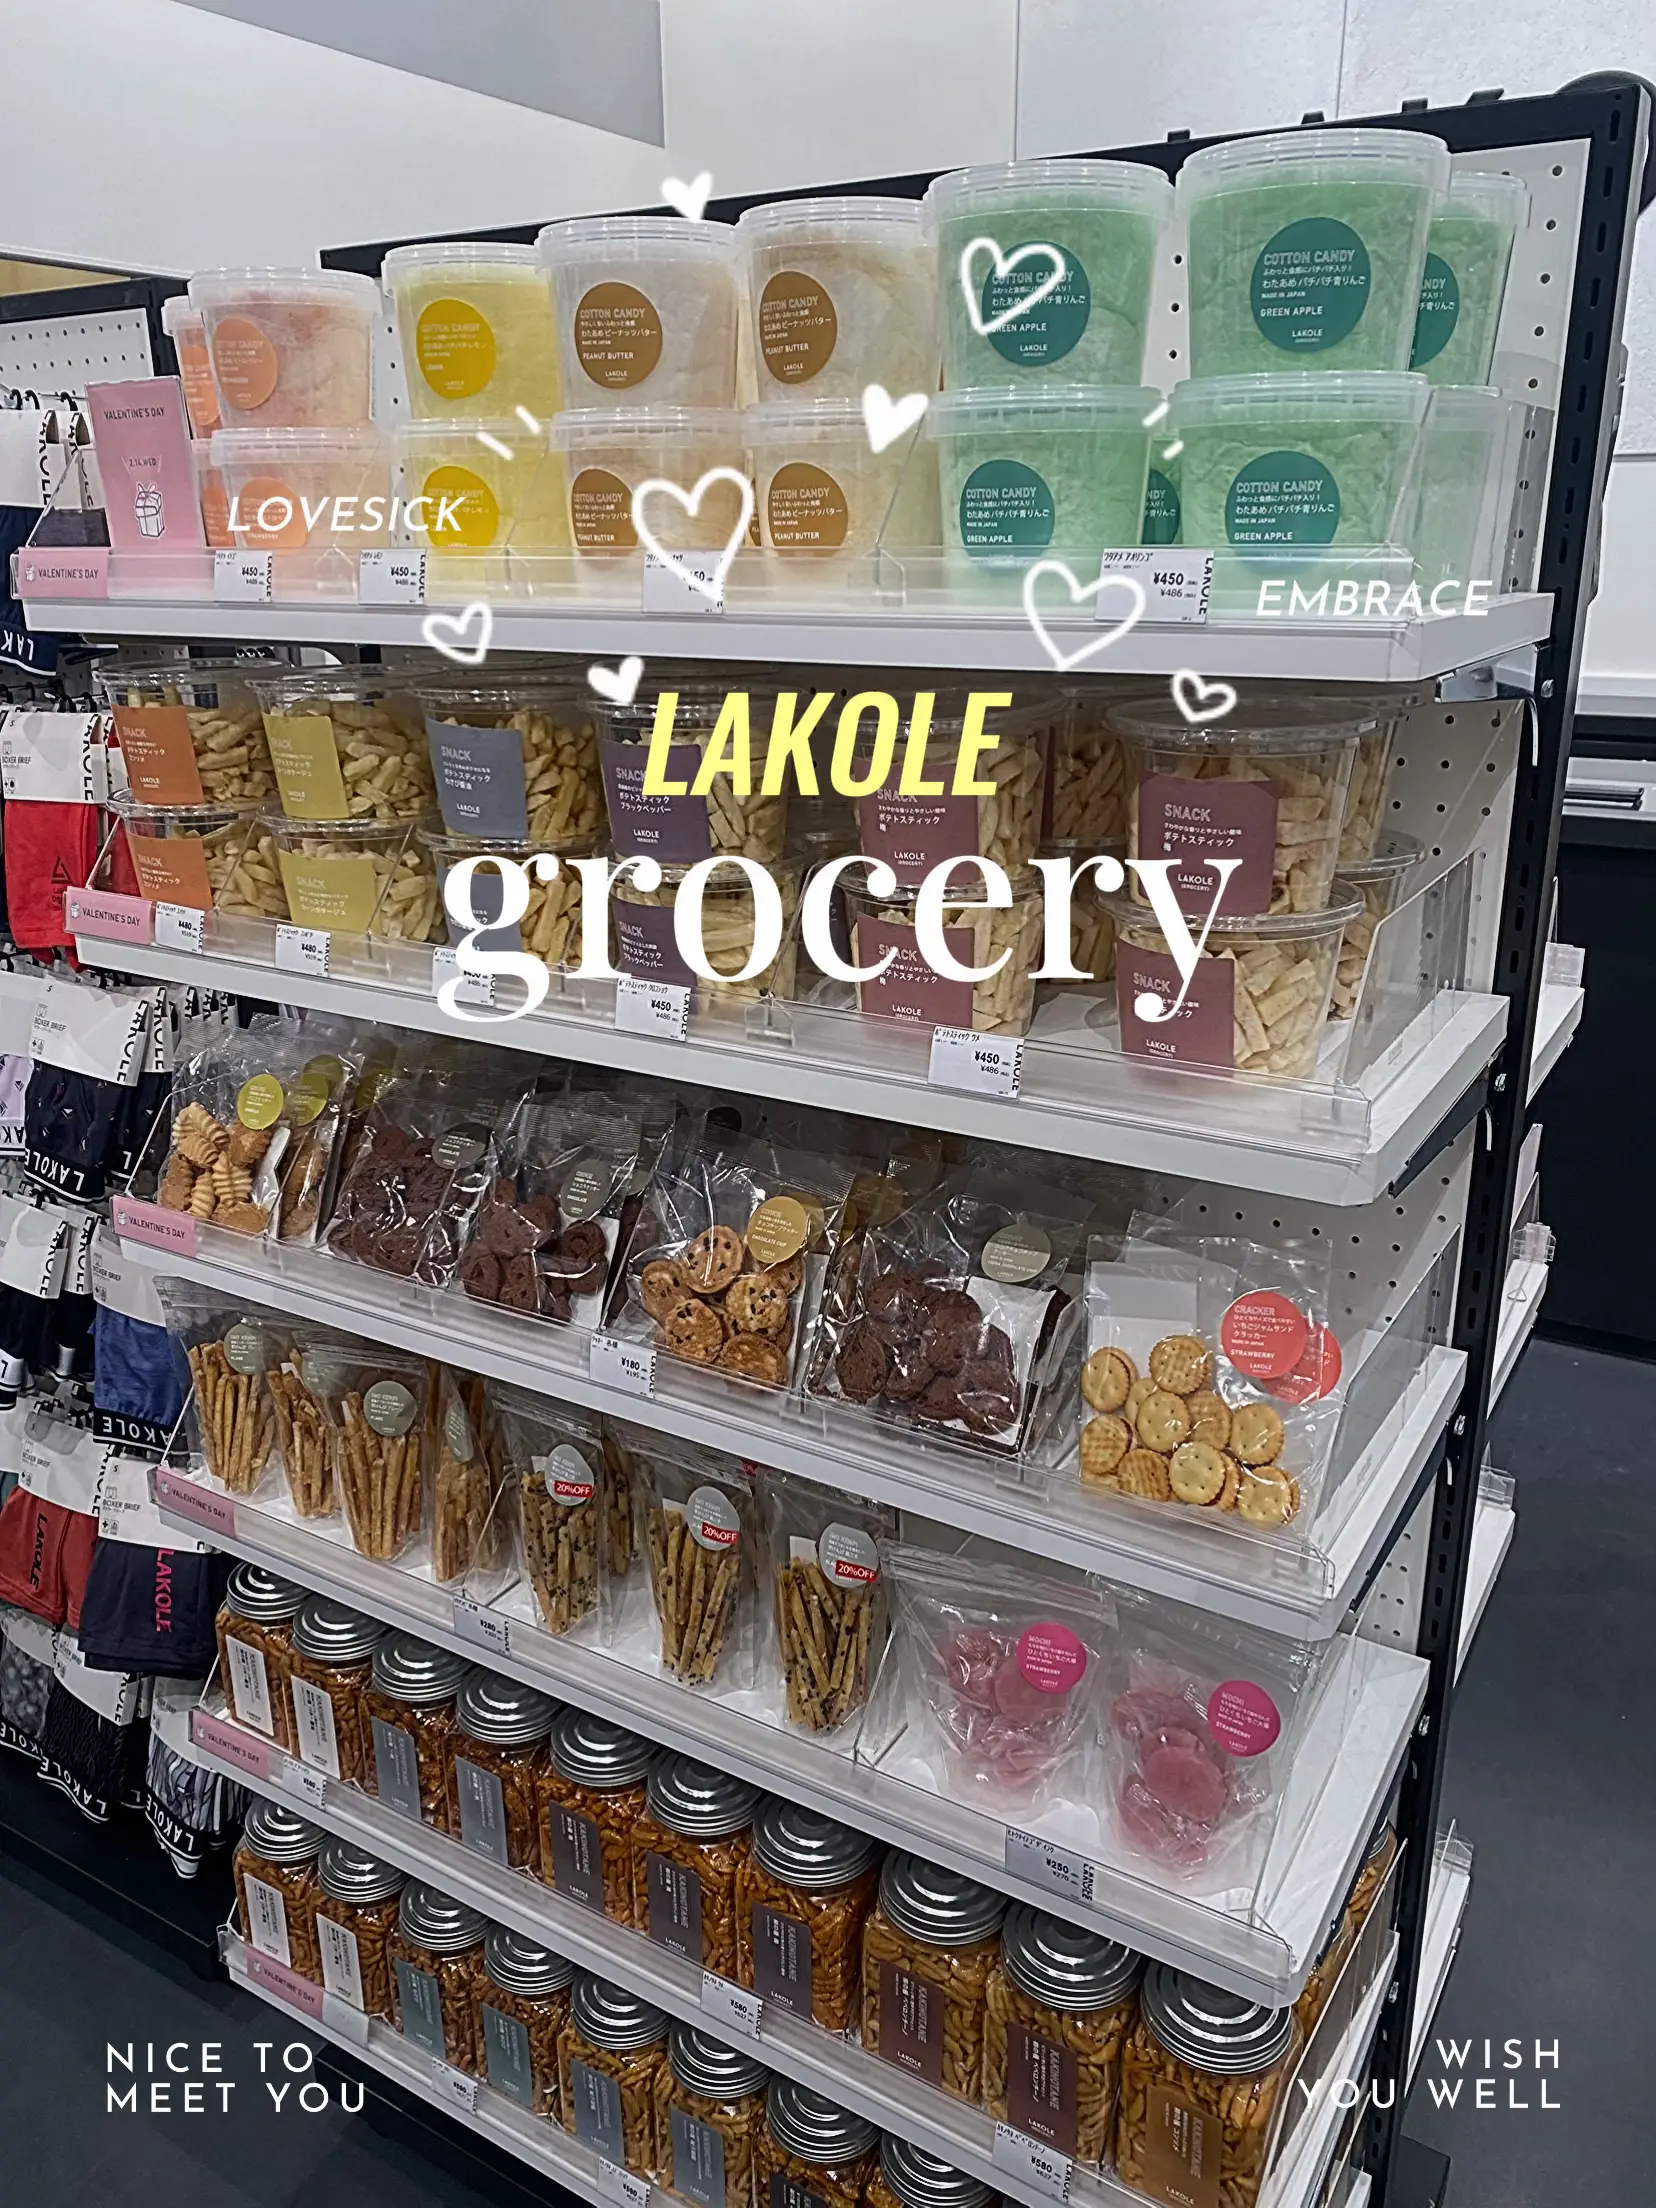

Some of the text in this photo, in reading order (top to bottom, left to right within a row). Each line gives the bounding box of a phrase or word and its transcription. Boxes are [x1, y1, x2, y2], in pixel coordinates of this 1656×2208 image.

[1263, 249, 1355, 266] COTTON CANDY
[1262, 275, 1366, 289] わたあめ パチパチ青りんご
[762, 296, 819, 313] COTTON CANDY
[992, 297, 1021, 306] わたあめ
[580, 307, 646, 319] COTTON CANDY
[1260, 306, 1323, 317] GREEN APPLE
[781, 317, 832, 329] ピーナッツバター
[1019, 323, 1047, 331] APPLE
[605, 329, 658, 337] ピーナッツバター
[1292, 329, 1323, 338] LAKOLE
[765, 343, 809, 355] PEANUT BUTTER
[1020, 344, 1047, 352] LAKOLE
[784, 363, 804, 371] LAKOLE
[104, 407, 165, 420] VALENTINE'S DAY
[1235, 480, 1324, 493] COTTON CANDY
[573, 493, 624, 503] COTTON CANDY
[771, 487, 830, 500] COTTON CANDY
[966, 487, 1037, 499] COTTON CANDY
[792, 507, 842, 518] ピーナッツバター
[966, 508, 1050, 518] わたあめ パチパチ青りんご
[1235, 503, 1335, 515] わたあめ パチパチ青りんご
[594, 534, 615, 542] BUTTER
[775, 532, 820, 540] PEANUT BUTTER
[967, 534, 1012, 543] GREEN APPLE
[1234, 532, 1293, 541] GREEN APPLE
[38, 568, 99, 579] VALENTINE'S DAY
[241, 566, 258, 577] ¥450
[390, 566, 409, 577] ¥450
[1153, 573, 1184, 585] ¥450
[1198, 557, 1214, 615] LAKOLE
[1160, 588, 1183, 597] ¥486
[441, 745, 472, 761] SNACK
[140, 777, 160, 785] LAKOLE
[444, 768, 491, 782] ポテトスティック
[456, 803, 480, 814] LAKOLE
[620, 802, 671, 814] ブラックペッパー
[1164, 803, 1211, 822] SNACK
[879, 813, 941, 825] ポテトスティック
[633, 829, 659, 839] LAKOLE
[1164, 831, 1235, 847] ポテトスティック
[894, 851, 925, 861] LAKOLE
[1177, 873, 1214, 886] LAKOLE
[82, 907, 141, 926] VALENTINE'S DAY
[619, 920, 644, 938] SNACK
[1133, 972, 1171, 993] SNACK
[651, 1000, 671, 1012] ¥450
[892, 1004, 921, 1016] LAKOLE
[681, 993, 691, 1035] LAKOLE
[1146, 1038, 1176, 1053] LAKOLE
[974, 1050, 1000, 1065] ¥450
[980, 1065, 999, 1075] ¥486
[1011, 1044, 1023, 1092] LAKOLE
[25, 1148, 85, 1191] LAKOLE
[128, 1216, 186, 1239] VALENTINE'S DAY
[1234, 1304, 1276, 1316] CRACKER
[1232, 1321, 1294, 1333] いちごジャムサンド
[1234, 1330, 1267, 1340] クラッカー
[1230, 1349, 1276, 1359] STRAWBERRY
[621, 1357, 640, 1371] ¥180
[1249, 1363, 1273, 1371] LAKOLE
[556, 1484, 592, 1496] 20%OFF
[102, 1498, 141, 1513] BOXER BRIEF
[172, 1488, 227, 1520] VALENTINE'S DAY
[703, 1525, 737, 1542] 20%OFF
[29, 1512, 47, 1590] LAKOLE
[838, 1563, 875, 1578] 20%OFF
[155, 1547, 175, 1634] LAKOLE
[1026, 1664, 1061, 1675] STRAWBERRY
[1216, 1721, 1251, 1739] STRAWBERRY
[246, 1754, 260, 1765] DAY
[40, 1756, 107, 1815] LAKOLE
[145, 1793, 195, 1852] LAKOLE
[1046, 1858, 1069, 1874] ¥250
[771, 1990, 793, 2006] LAKOLE
[730, 1999, 748, 2014] ¥580
[897, 2050, 922, 2068] LAKOLE
[1028, 2118, 1055, 2136] LAKOLE
[1031, 2155, 1053, 2173] ¥580
[1062, 2163, 1072, 2200] LAKOLE
[1165, 2186, 1194, 2205] LAKOLE
